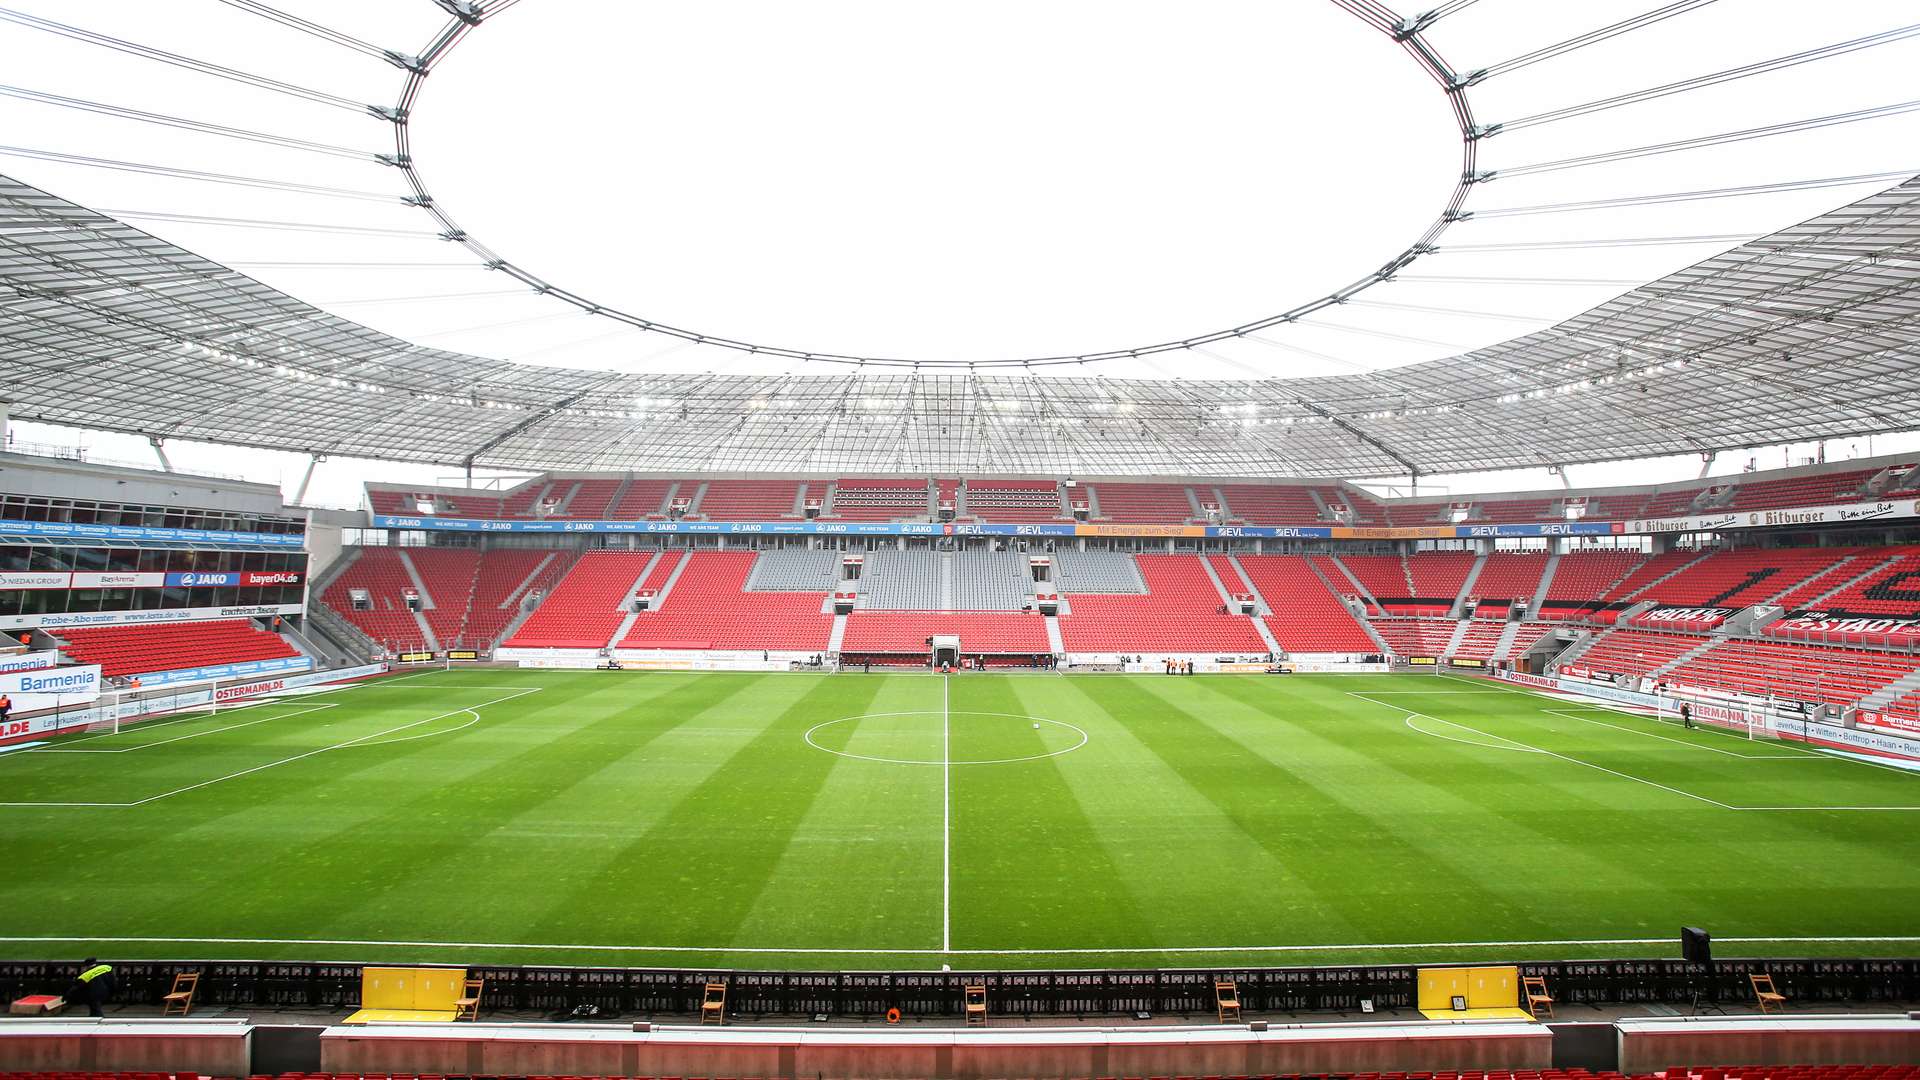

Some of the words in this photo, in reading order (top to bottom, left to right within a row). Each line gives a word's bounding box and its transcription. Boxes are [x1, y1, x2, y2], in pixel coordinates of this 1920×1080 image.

[397, 518, 421, 527] JAKO
[1765, 511, 1825, 525] Bitburger
[34, 523, 73, 531] Barmenia
[75, 525, 110, 533] Barmenia
[111, 526, 144, 535] Barmenia
[826, 524, 847, 532] JAKO
[911, 525, 932, 533] JAKO
[965, 525, 983, 535] EVL
[1026, 525, 1043, 535] EVL
[1097, 526, 1110, 535] Mit
[1112, 526, 1142, 536] Energie
[1144, 526, 1160, 535] zum
[1164, 526, 1184, 536] Sieg!
[1480, 526, 1501, 536] EVL
[1552, 525, 1573, 535] EVL
[1646, 520, 1689, 532] Bitburger
[1227, 528, 1243, 537] EVL
[1285, 528, 1301, 537] EVL
[1352, 528, 1365, 537] Mit
[1366, 528, 1394, 538] Energie
[1396, 528, 1416, 537] zum
[1419, 527, 1440, 537] Sieg!
[8, 577, 35, 585] NIEDAX
[36, 577, 62, 585] GROUP
[197, 574, 227, 585] JAKO
[250, 573, 298, 586] bayer04.de
[41, 615, 91, 625] Probe-Abo
[167, 670, 198, 679] Barmenia
[20, 671, 94, 691] Barmenia
[1510, 672, 1558, 689] OSTERMANN.DE
[216, 681, 284, 699] OSTERMANN.DE
[1815, 727, 1837, 737] Witten
[1843, 732, 1870, 745] Bottrop
[1876, 738, 1897, 749] Haan
